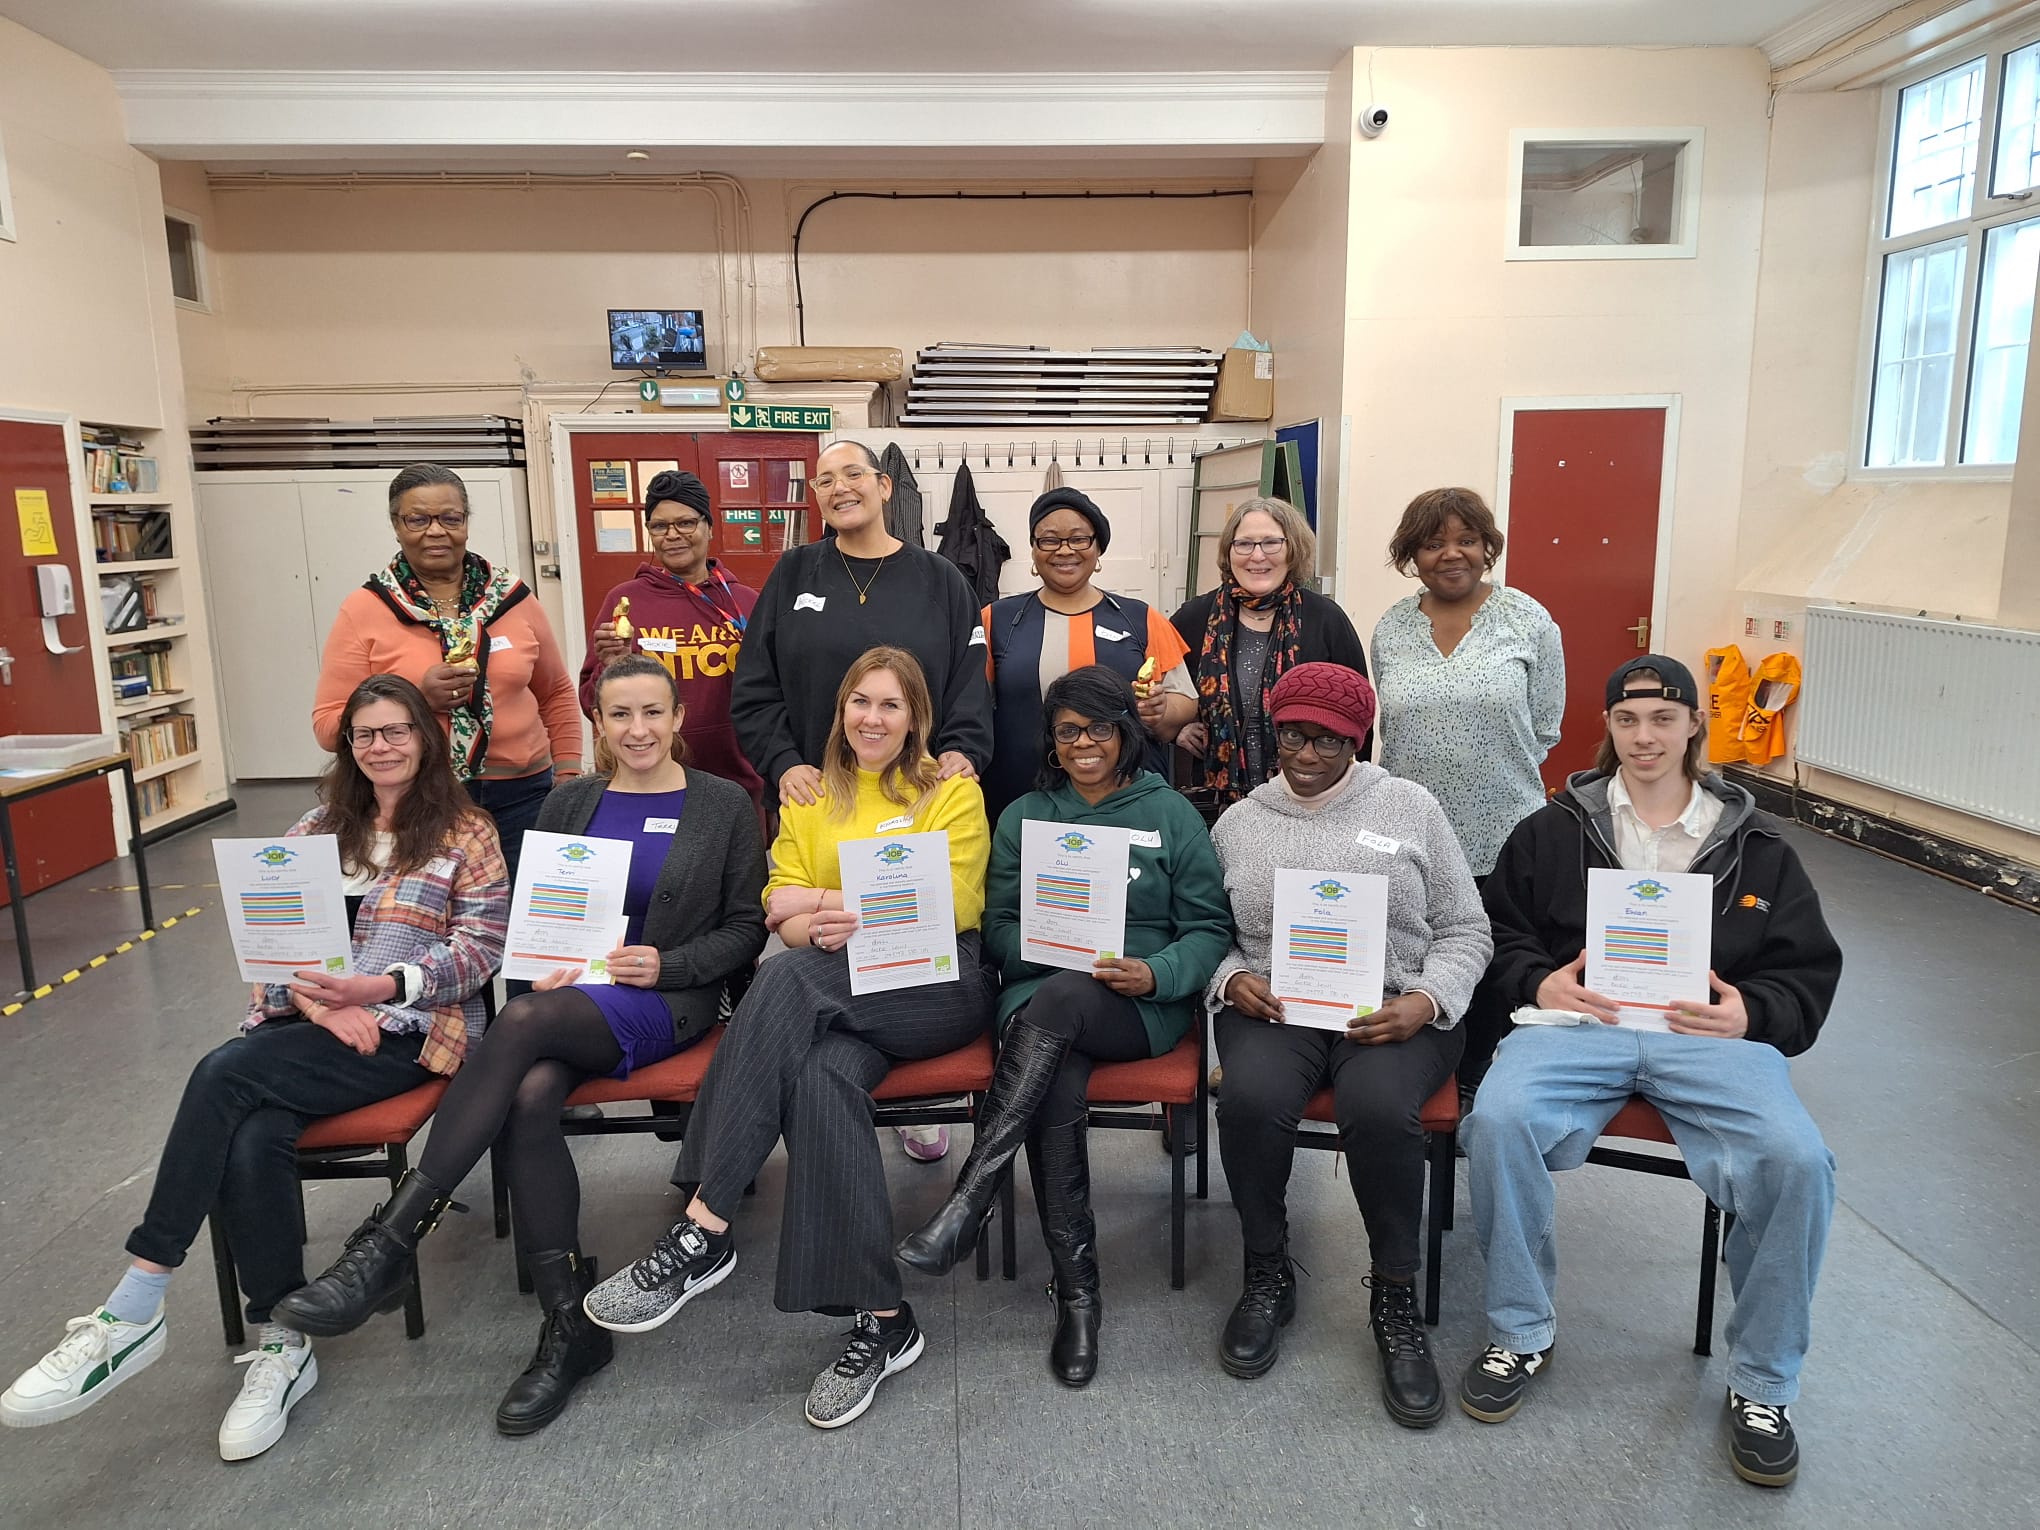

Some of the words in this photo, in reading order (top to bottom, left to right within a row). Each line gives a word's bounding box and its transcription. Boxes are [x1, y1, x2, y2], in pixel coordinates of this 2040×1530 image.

[774, 410, 800, 425] FIRE
[804, 411, 829, 425] EXIT
[726, 509, 757, 520] FIRE
[886, 850, 903, 858] JOB
[1322, 886, 1339, 894] JOB
